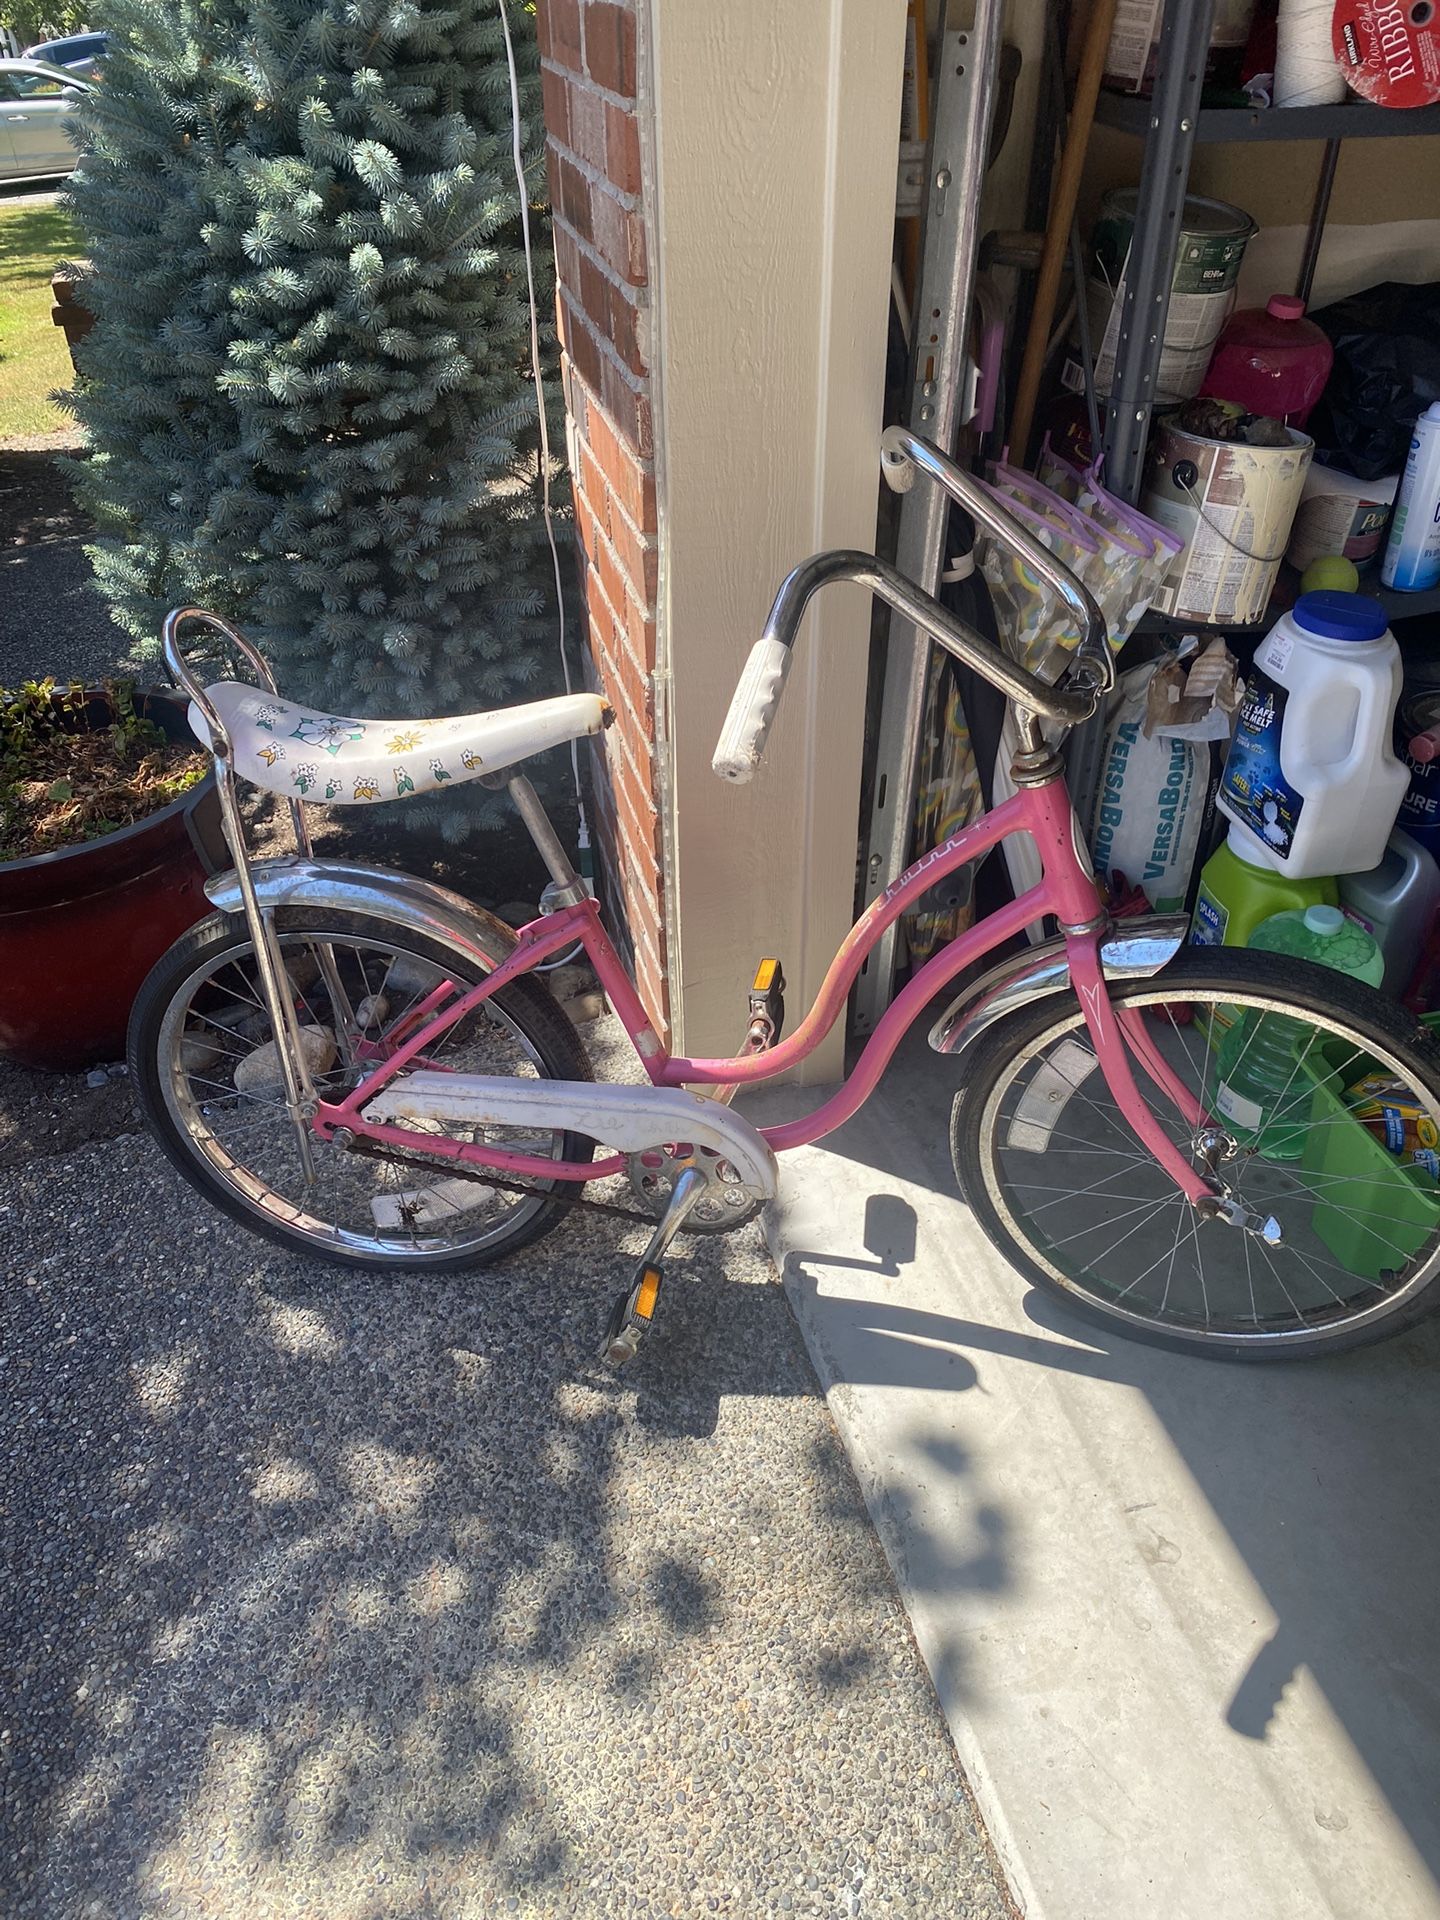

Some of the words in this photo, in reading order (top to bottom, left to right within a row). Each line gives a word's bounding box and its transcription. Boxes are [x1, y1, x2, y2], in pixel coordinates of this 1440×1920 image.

[1343, 24, 1358, 65] KIRKLAND
[1249, 714, 1273, 728] MELT
[1253, 705, 1276, 720] SAFE
[1199, 901, 1219, 927] SPLASH
